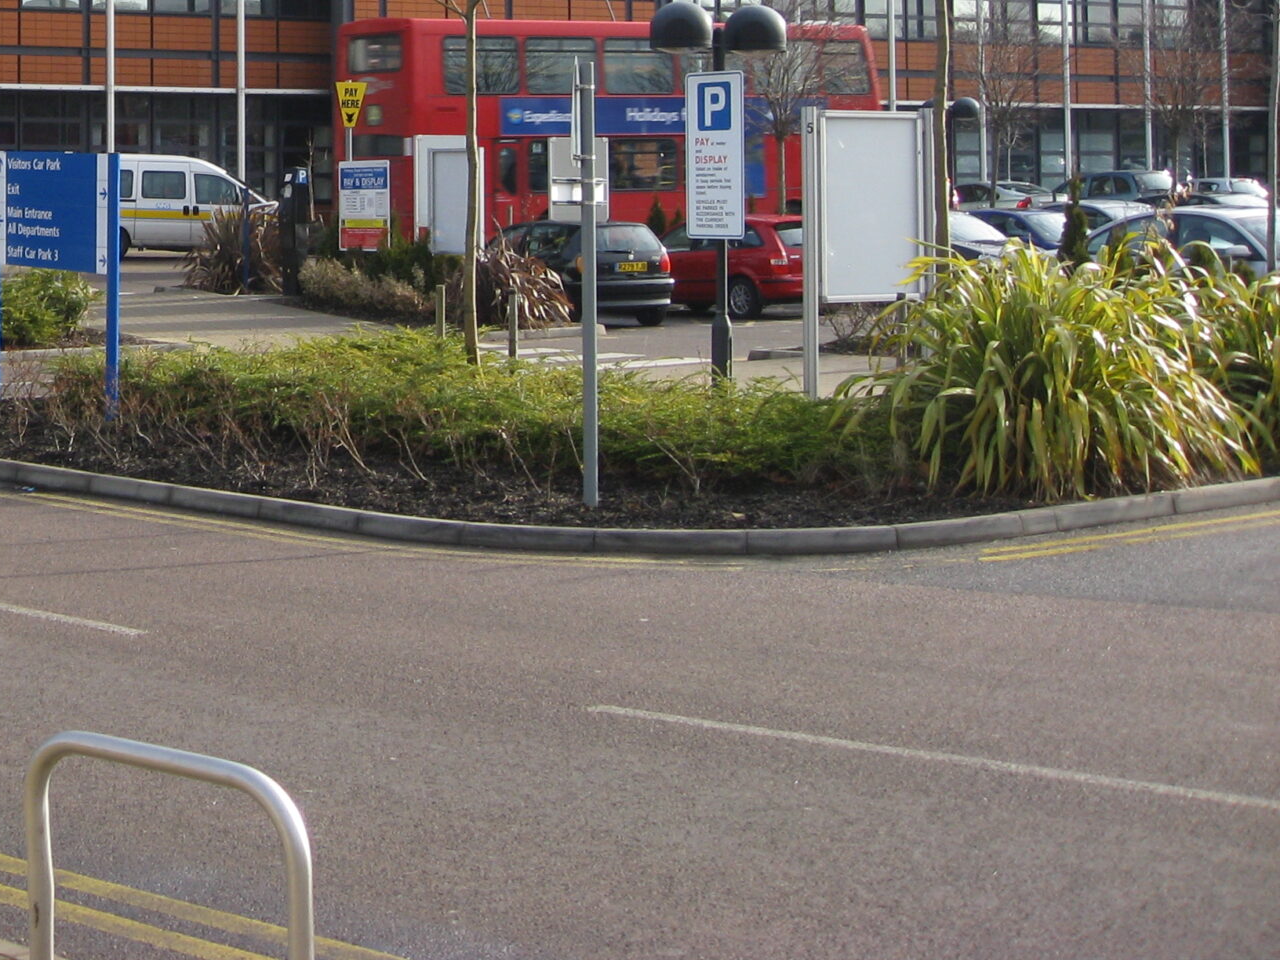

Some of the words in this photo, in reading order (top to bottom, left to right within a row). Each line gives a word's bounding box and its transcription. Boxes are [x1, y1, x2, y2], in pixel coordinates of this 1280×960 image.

[344, 88, 358, 97] PAY
[342, 99, 360, 108] HERE
[704, 86, 726, 126] P
[626, 108, 679, 124] Holidays
[806, 122, 814, 134] 5
[695, 138, 710, 146] PAY
[7, 158, 31, 169] Visitors
[33, 158, 44, 170] Car
[46, 158, 61, 170] Park
[695, 155, 728, 164] DISPLAY
[299, 170, 307, 183] P
[361, 177, 384, 186] DISPLAY
[7, 183, 20, 196] Exit
[8, 206, 23, 218] Main
[24, 207, 52, 220] Entrance
[8, 222, 16, 234] All
[18, 223, 60, 238] Departments
[8, 246, 23, 258] Staff
[24, 247, 36, 259] Car
[38, 248, 52, 260] Park
[54, 249, 59, 261] 3
